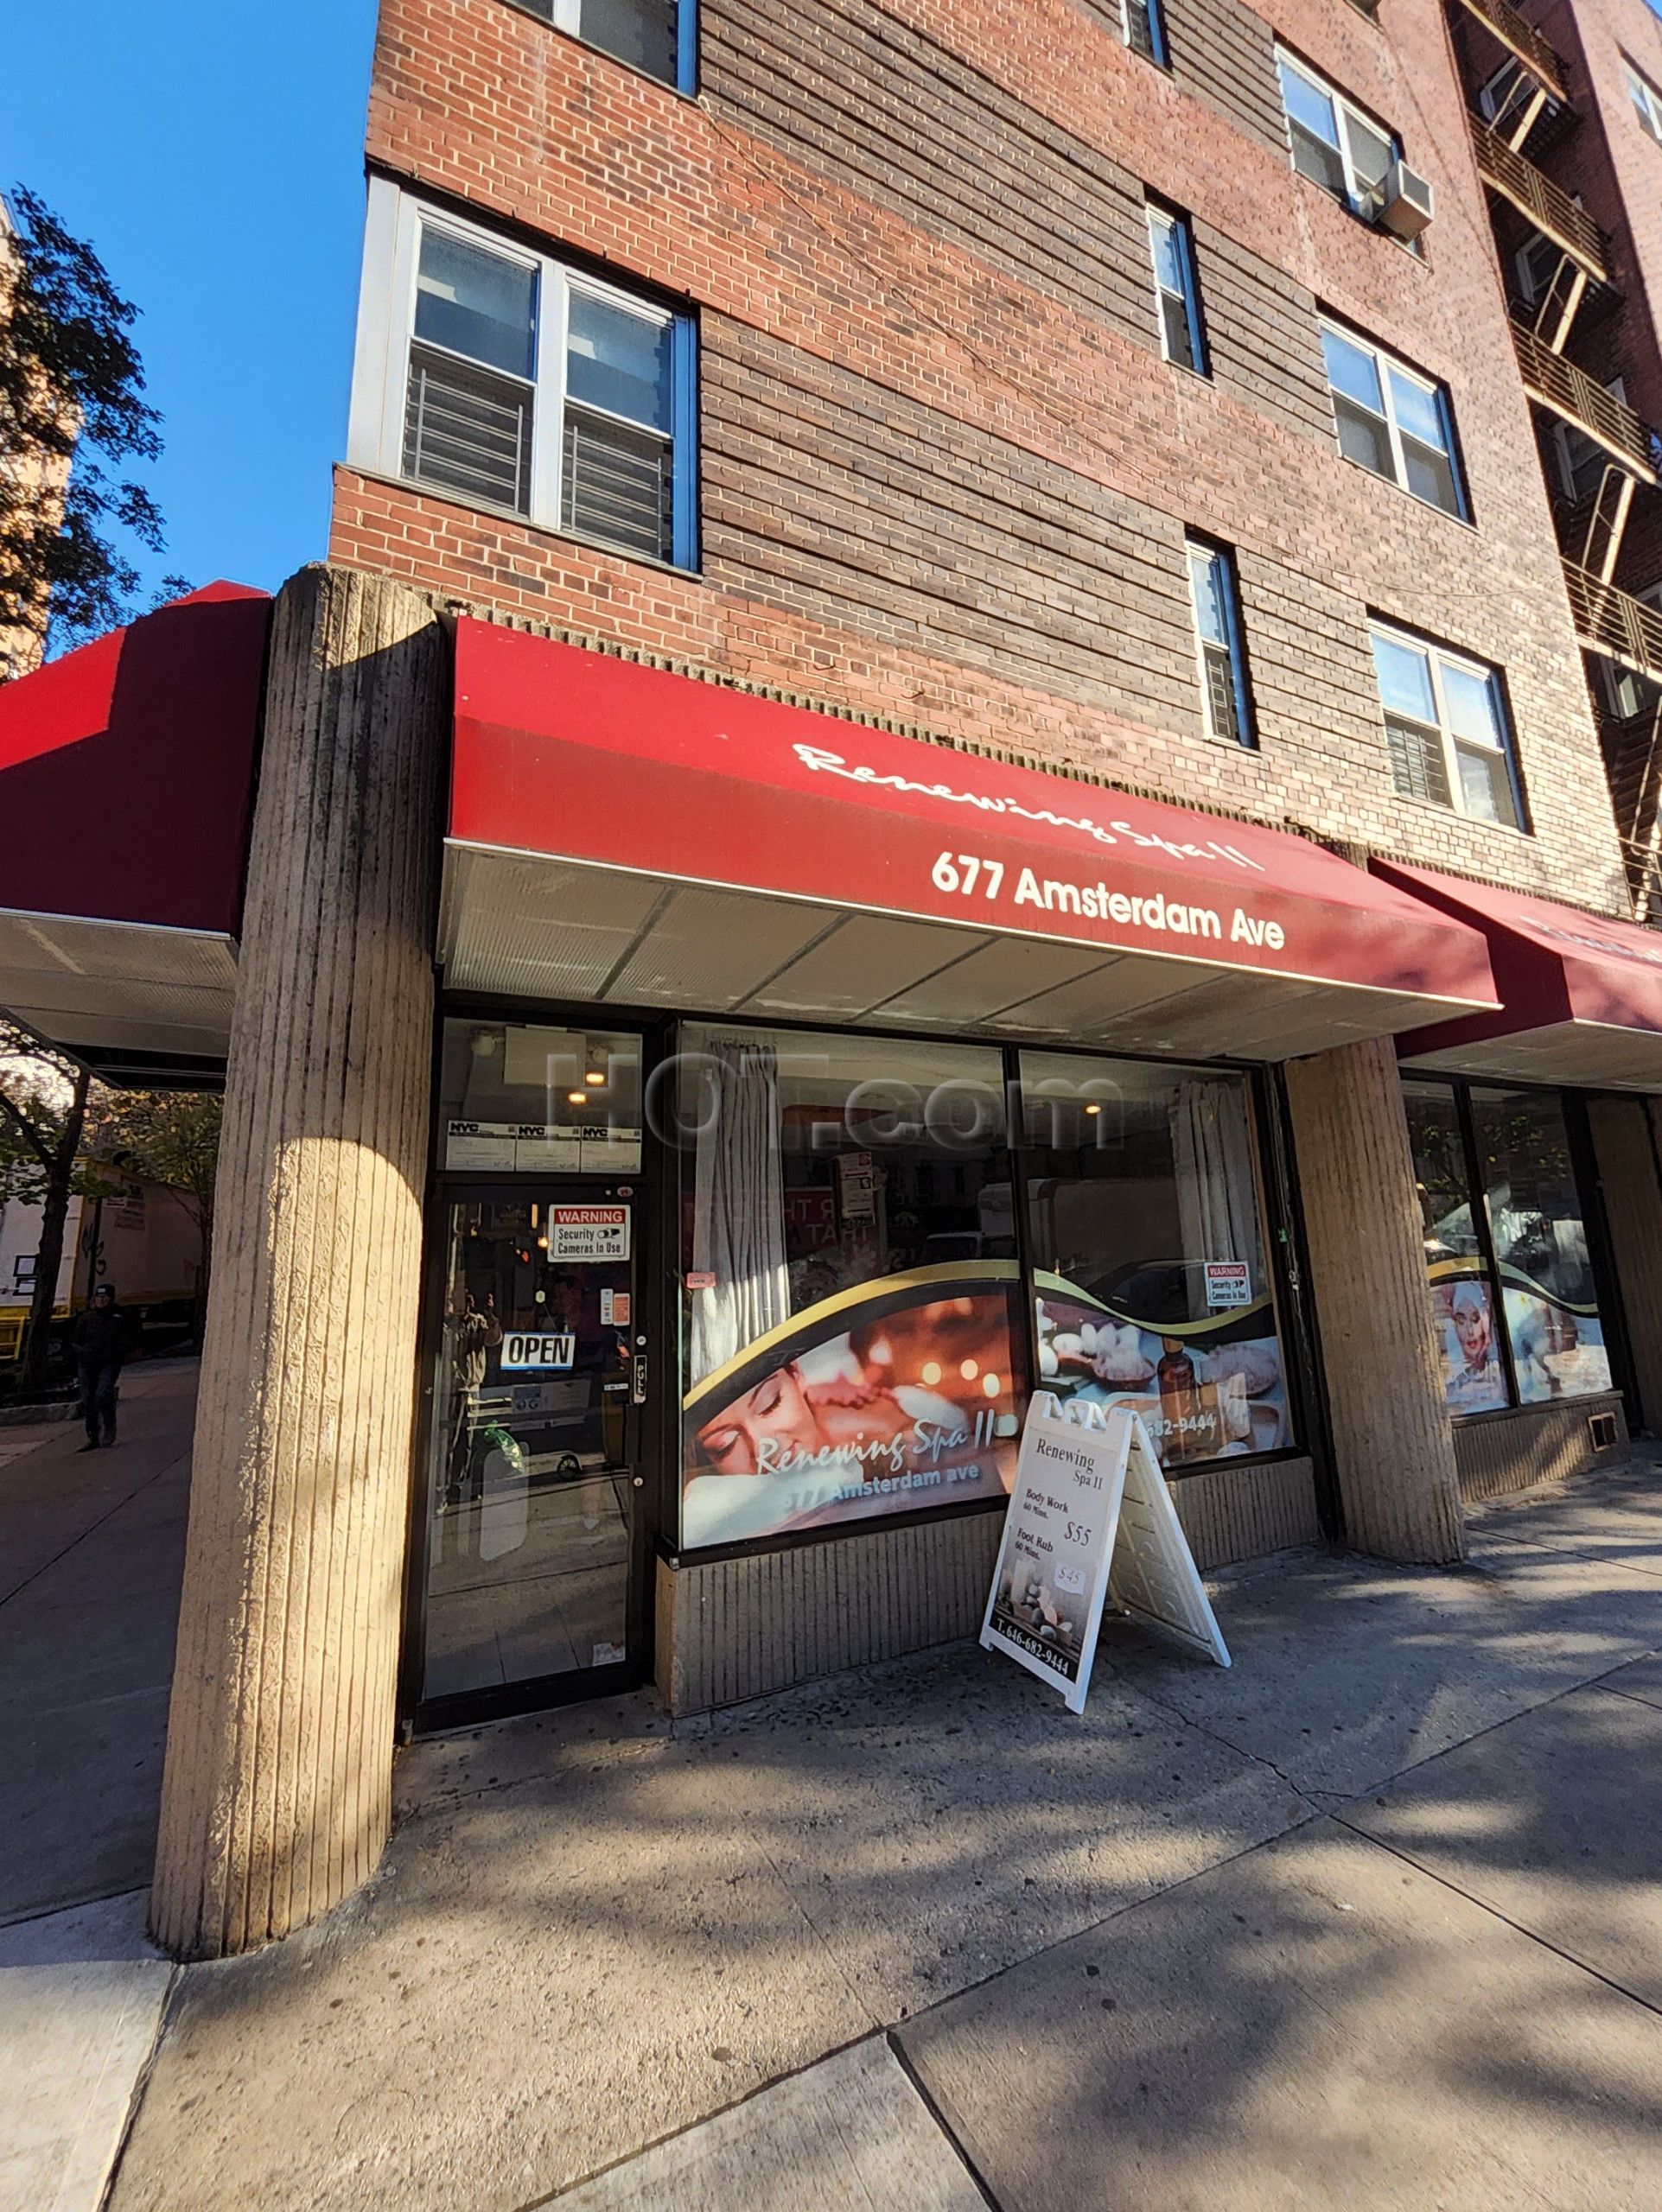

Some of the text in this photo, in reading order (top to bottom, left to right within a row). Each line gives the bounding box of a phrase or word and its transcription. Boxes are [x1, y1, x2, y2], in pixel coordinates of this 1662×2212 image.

[792, 743, 1117, 844] Renewing
[1111, 821, 1216, 860] Spa
[931, 851, 1286, 950] 677 Amsterdam Ave
[450, 1123, 479, 1133] NYC
[519, 1125, 545, 1135] NYC
[583, 1127, 608, 1137] NYC
[557, 1211, 622, 1224] WARNING
[558, 1228, 595, 1241] Security
[557, 1243, 594, 1254] Cameras
[606, 1242, 621, 1253] Use
[1210, 1266, 1245, 1276] WARNING
[508, 1337, 569, 1364] OPEN
[636, 1364, 646, 1395] PULL
[757, 1432, 906, 1475] Renewing
[913, 1417, 967, 1464] Spa
[1036, 1438, 1095, 1475] Renewing
[830, 1470, 940, 1502] Amsterdam
[946, 1463, 979, 1484] ave
[1073, 1470, 1091, 1487] Spa
[1026, 1489, 1068, 1513] Body Work
[1017, 1528, 1054, 1552] Foot Rub
[997, 1618, 1069, 1675] T. 646-682-9444
